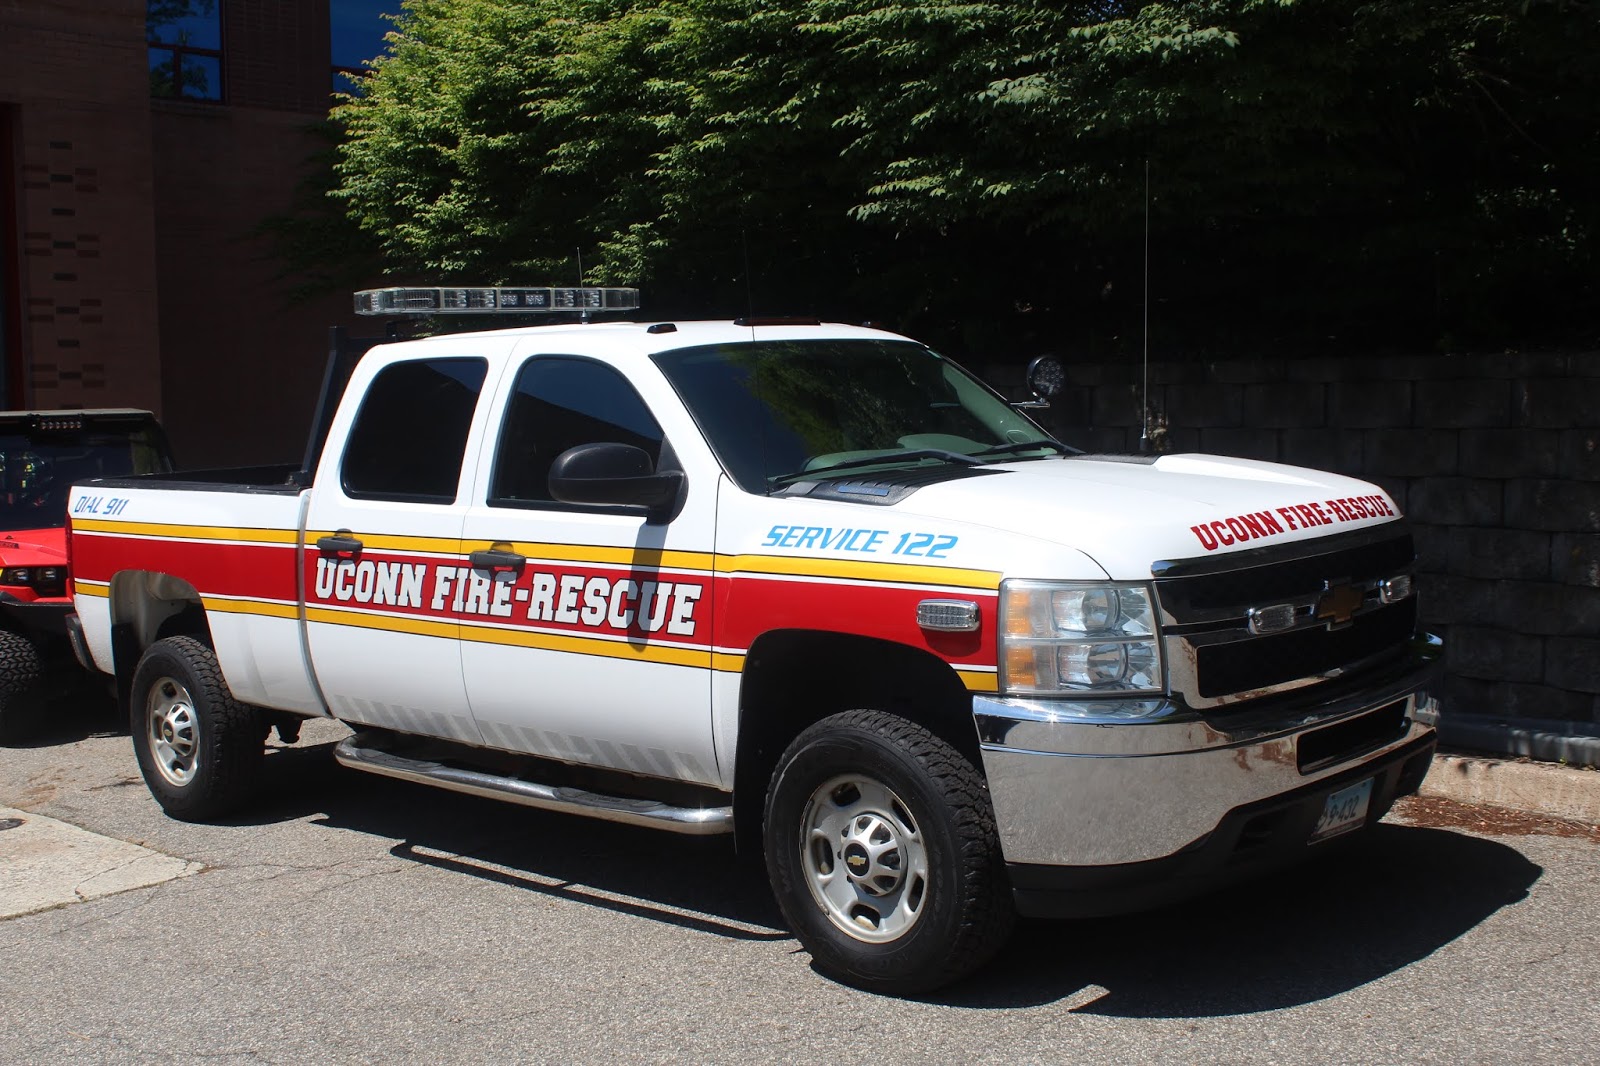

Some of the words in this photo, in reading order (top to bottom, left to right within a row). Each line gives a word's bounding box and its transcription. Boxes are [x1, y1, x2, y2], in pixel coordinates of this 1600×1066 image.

[74, 496, 103, 513] DIAL
[102, 498, 130, 515] 911
[1190, 511, 1285, 551] UCONN
[1275, 495, 1395, 531] FIRE-RESCUE
[761, 525, 889, 553] SERVICE
[891, 532, 959, 559] 122
[315, 557, 427, 608] UCONN
[430, 565, 703, 637] FIRE-RESCUE
